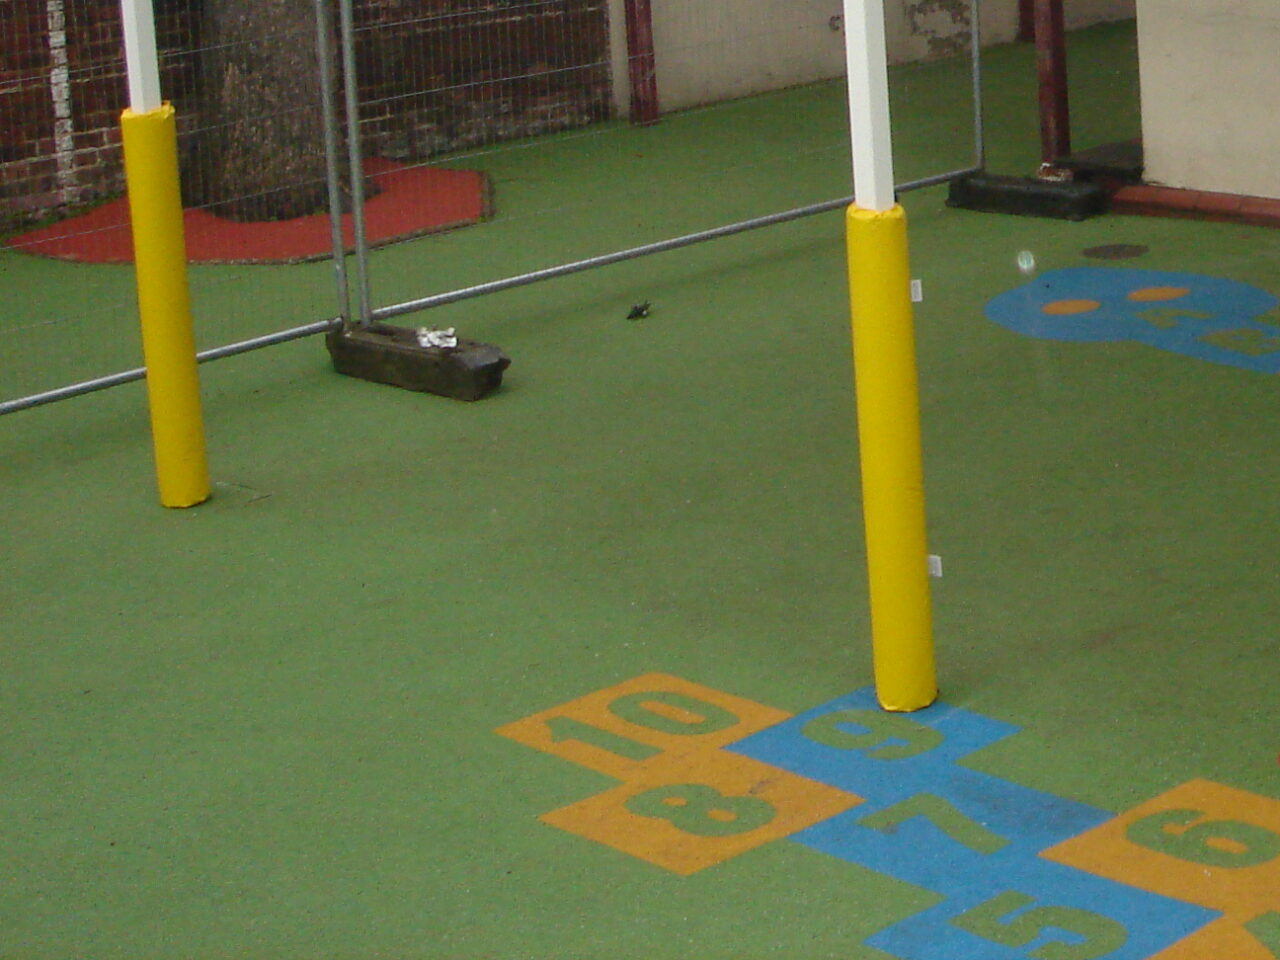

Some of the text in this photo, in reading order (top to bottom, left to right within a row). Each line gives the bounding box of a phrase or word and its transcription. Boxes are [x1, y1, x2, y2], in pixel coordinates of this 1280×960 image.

[545, 690, 742, 762] 10
[803, 709, 945, 761] 9
[624, 783, 778, 837] 8
[855, 793, 1013, 855] 7
[949, 890, 1129, 960] 5
